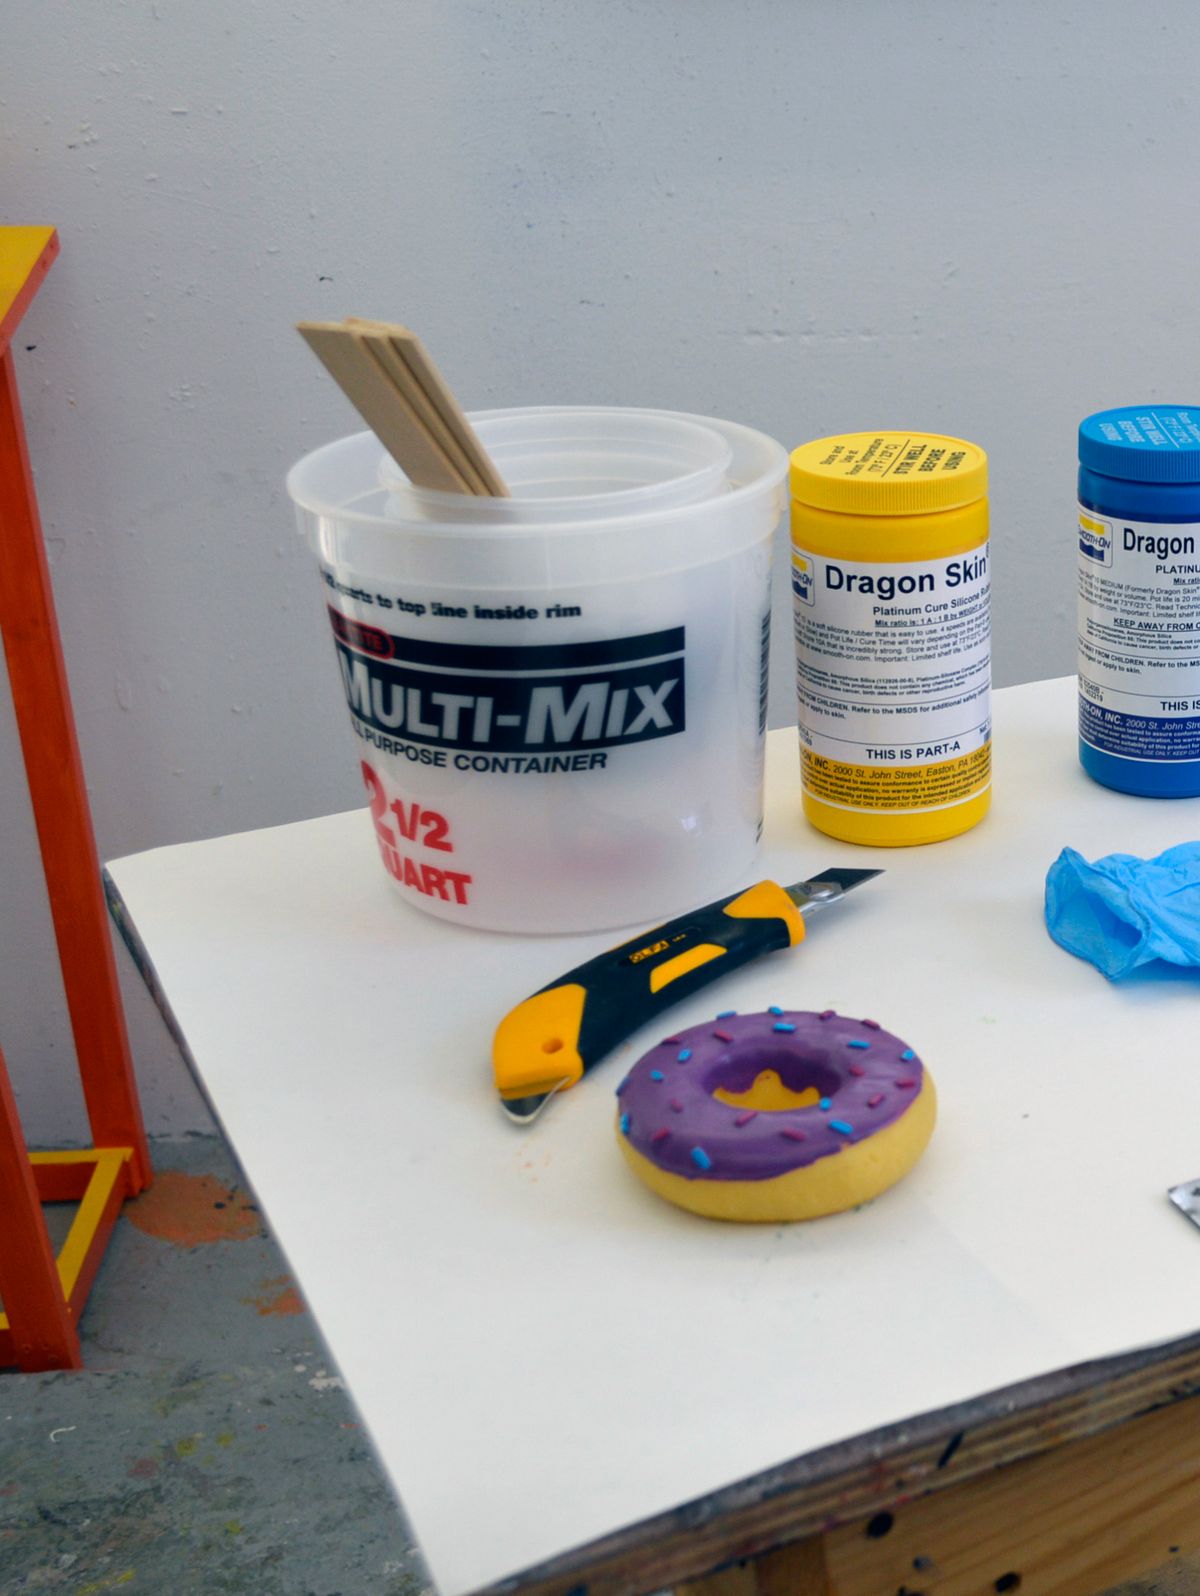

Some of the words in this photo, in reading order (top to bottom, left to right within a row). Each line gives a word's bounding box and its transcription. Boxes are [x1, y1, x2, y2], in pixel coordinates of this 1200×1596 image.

[918, 448, 946, 471] BEFORE
[1123, 527, 1194, 560] Dragon
[825, 564, 934, 600] Dragon
[946, 556, 986, 588] Skin
[376, 594, 393, 609] to
[398, 598, 426, 617] top
[431, 602, 468, 618] line
[474, 604, 538, 620] inside
[546, 603, 582, 619] rim
[873, 606, 921, 616] Platinum
[925, 602, 948, 613] Cure
[951, 592, 979, 608] Silicone
[827, 625, 850, 635] silicone
[1114, 617, 1135, 627] KEEP
[1138, 621, 1164, 630] AWAY
[1167, 622, 1193, 631] FROM
[927, 632, 958, 643] depending
[845, 645, 878, 654] incredibly
[912, 653, 936, 661] Limited
[1095, 648, 1110, 659] FROM
[338, 649, 679, 744] MULTI-MIX
[852, 705, 870, 714] Refer
[920, 704, 930, 712] for
[932, 698, 962, 711] additional
[1160, 701, 1188, 711] THIS
[1105, 712, 1123, 725] INC.
[1126, 719, 1146, 728] 2000
[1148, 722, 1159, 730] St.
[1162, 722, 1183, 730] John
[365, 729, 447, 768] PURPOSE
[454, 753, 607, 774] CONTAINER
[866, 749, 896, 760] THIS
[900, 749, 912, 760] IS
[917, 741, 960, 758] PART-A
[833, 765, 852, 776] 2000
[869, 771, 891, 779] John
[378, 838, 472, 905] UART
